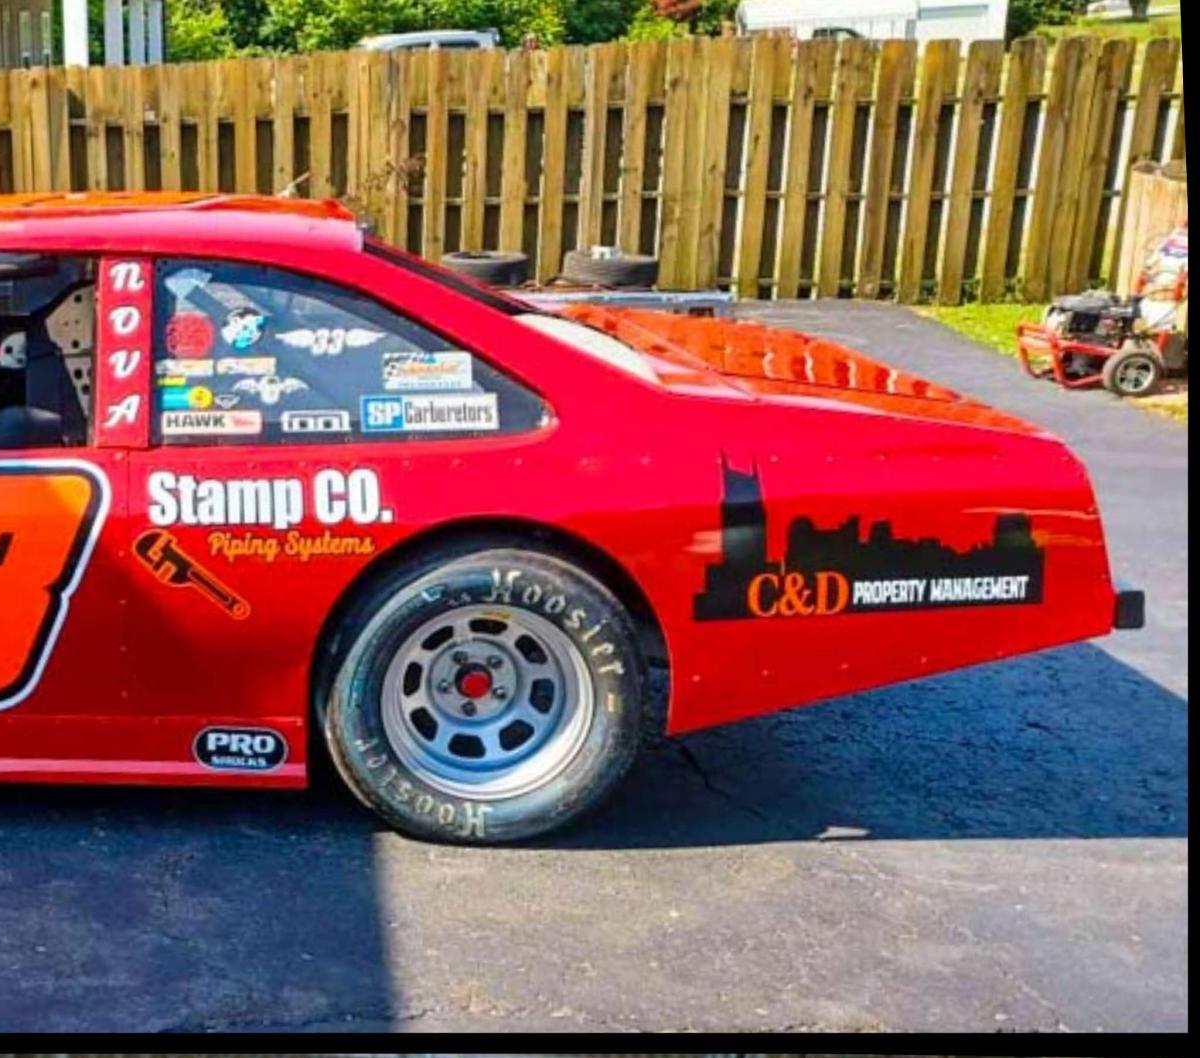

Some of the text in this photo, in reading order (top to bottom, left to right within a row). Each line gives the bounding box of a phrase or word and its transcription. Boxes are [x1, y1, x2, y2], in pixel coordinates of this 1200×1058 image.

[165, 413, 226, 429] HAWK
[366, 399, 493, 426] SP Carburetors
[148, 468, 394, 529] Stamp CO.
[208, 530, 375, 562] Piping Systems
[747, 571, 1030, 617] C&D PROPERTY MANAGEMENT
[483, 567, 625, 675] Hoosier
[206, 732, 276, 755] PRO
